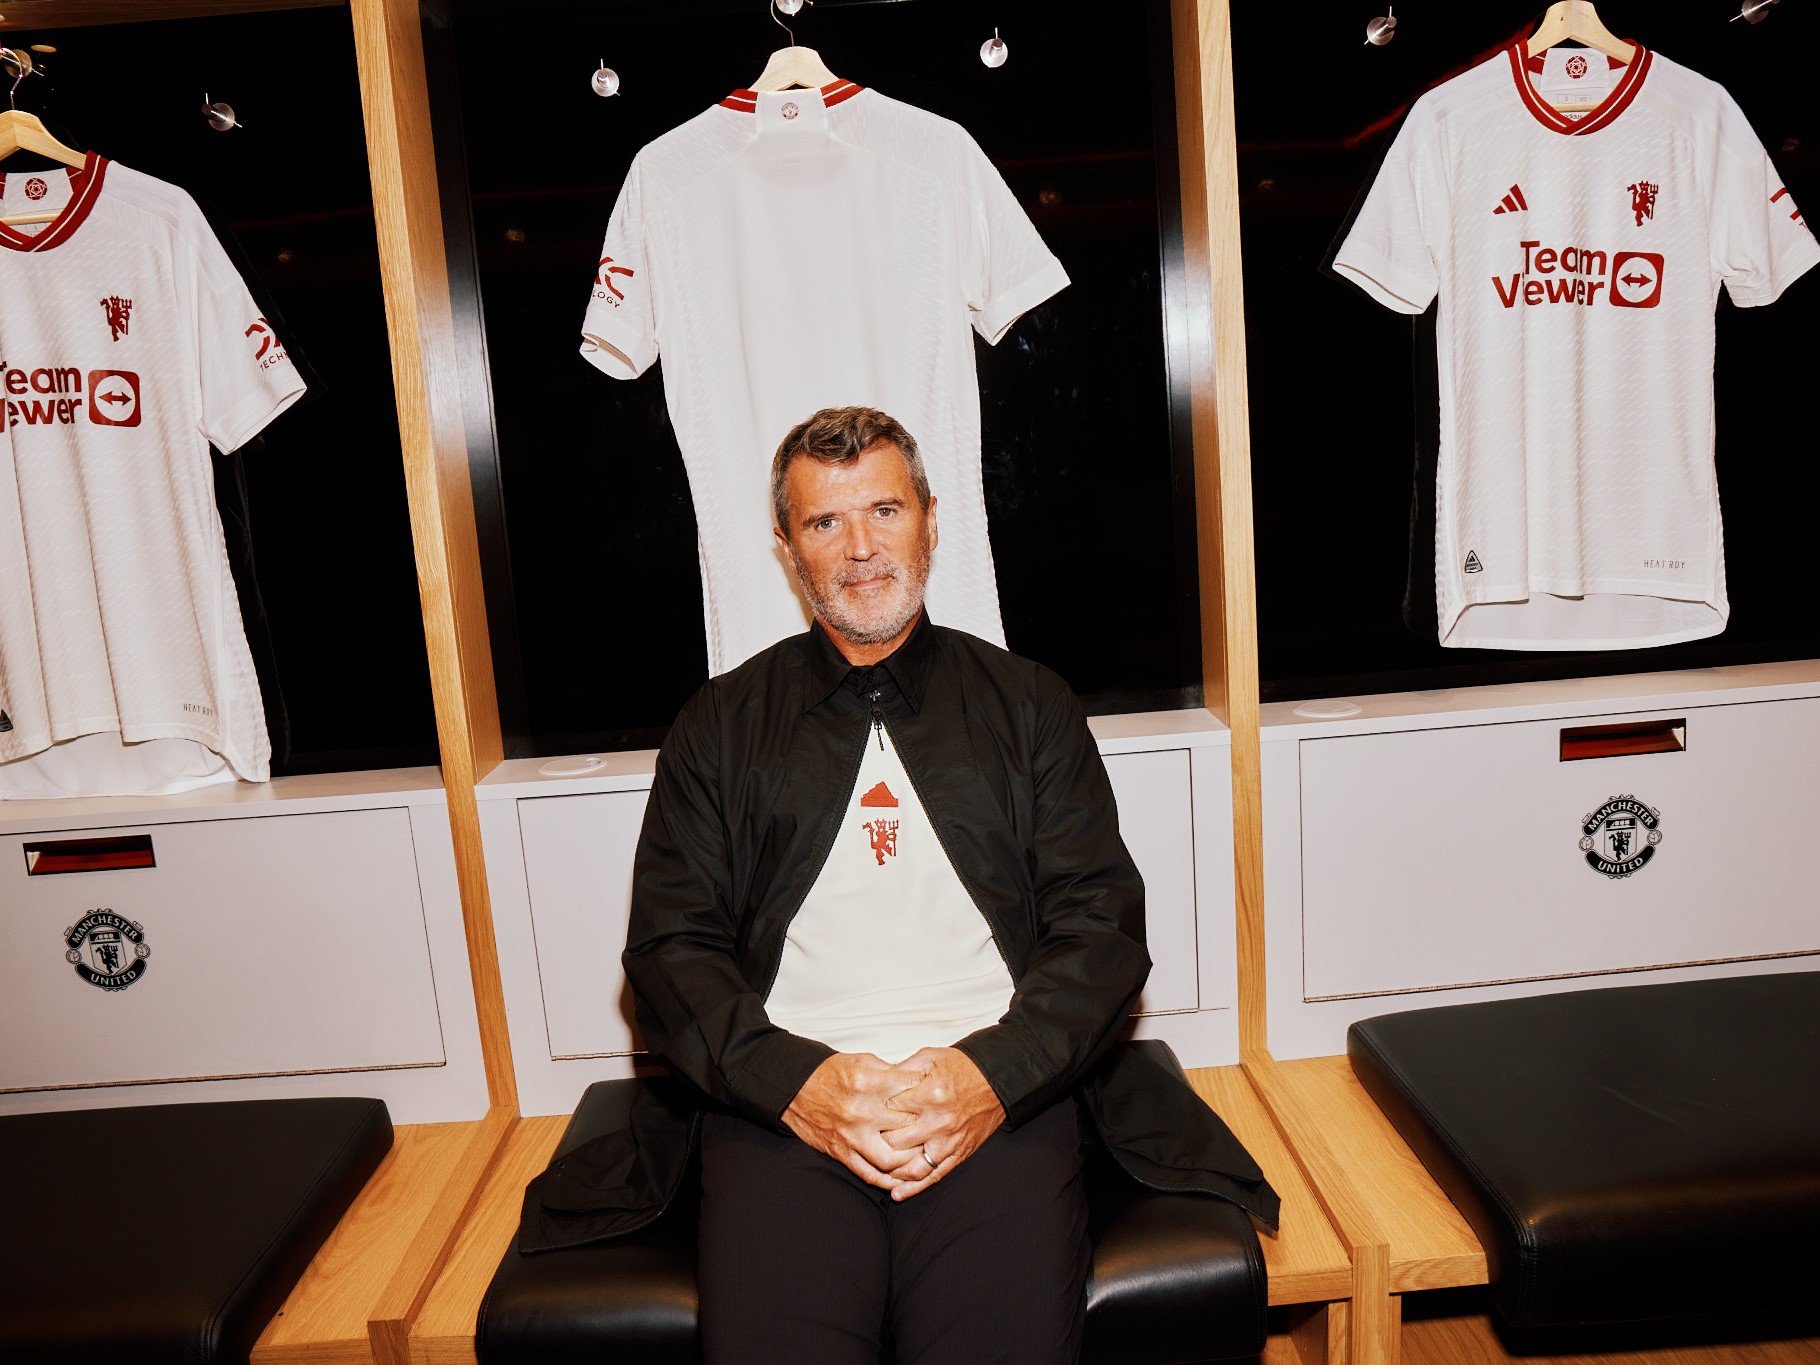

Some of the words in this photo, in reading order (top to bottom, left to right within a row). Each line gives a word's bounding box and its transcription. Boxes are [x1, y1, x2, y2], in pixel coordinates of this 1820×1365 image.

[1519, 240, 1607, 275] Team
[0, 361, 82, 395] eam
[0, 397, 82, 433] ewer
[1588, 801, 1654, 831] MANCHESTER
[1597, 857, 1644, 873] UNITED
[71, 915, 138, 944] MANCHESTER
[90, 970, 137, 986] UNITED
